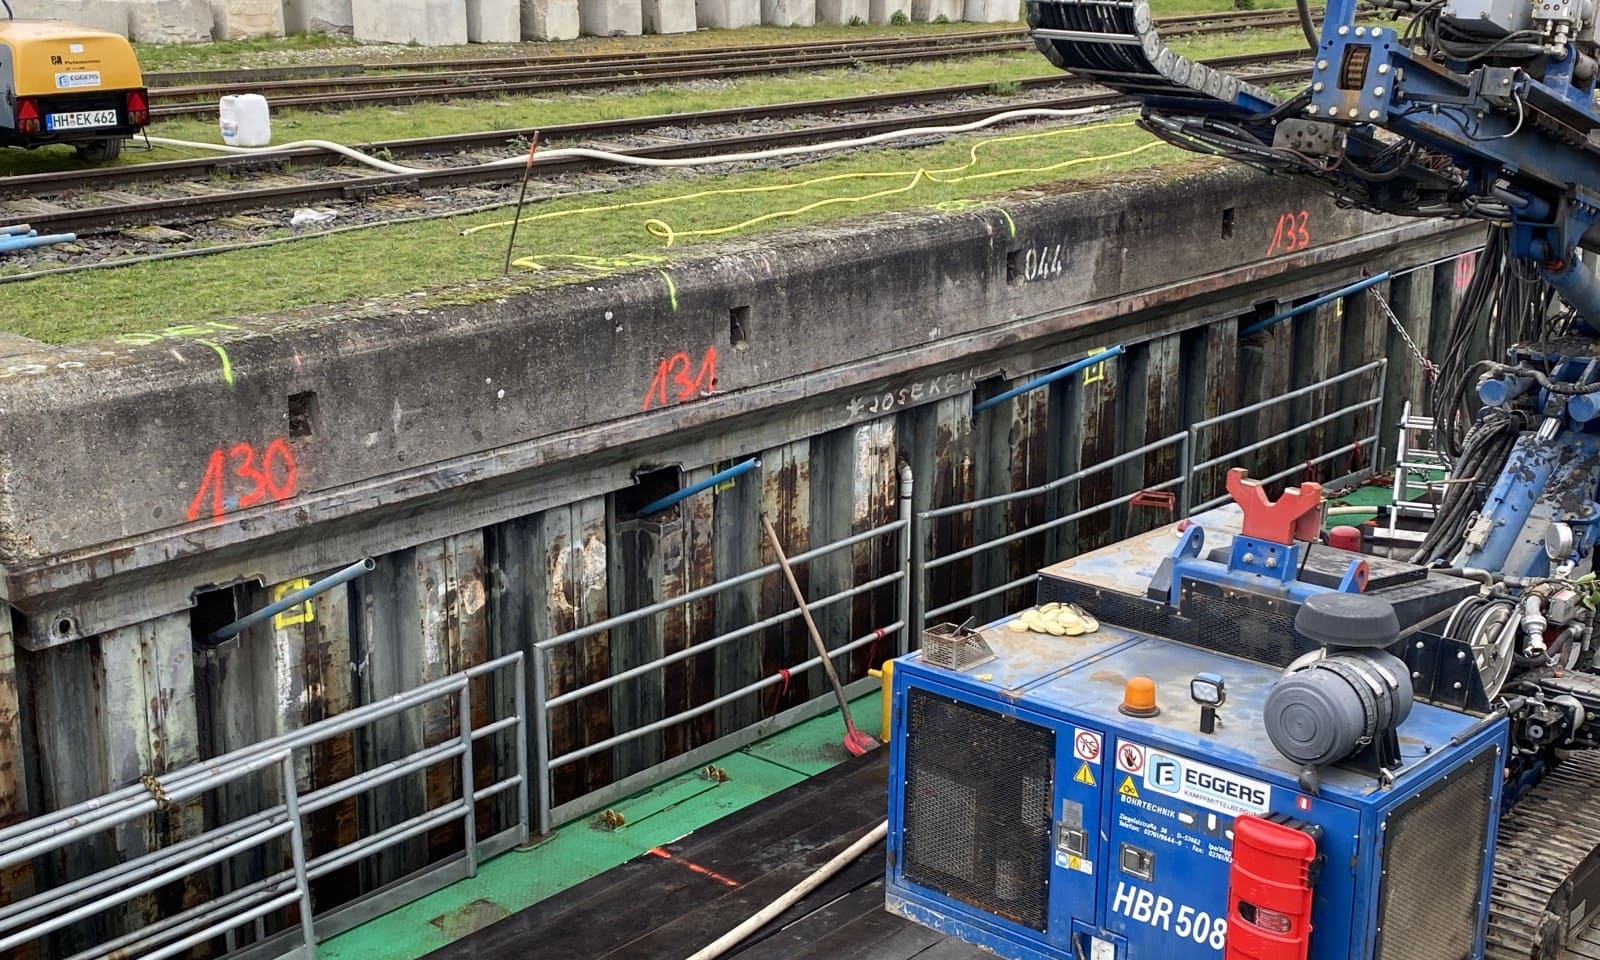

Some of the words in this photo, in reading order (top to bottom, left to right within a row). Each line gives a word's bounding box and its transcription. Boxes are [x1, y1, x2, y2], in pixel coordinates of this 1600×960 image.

[53, 114, 69, 128] HH
[76, 112, 92, 126] EK
[94, 111, 115, 124] 462
[1265, 210, 1310, 257] 133
[1025, 244, 1062, 281] 044
[641, 344, 717, 411] 131
[186, 437, 297, 523] 130
[1120, 794, 1176, 819] BOHRTECHNIK
[1185, 768, 1265, 806] EGGERS
[1112, 881, 1174, 931] HBR
[1175, 905, 1227, 951] 508
